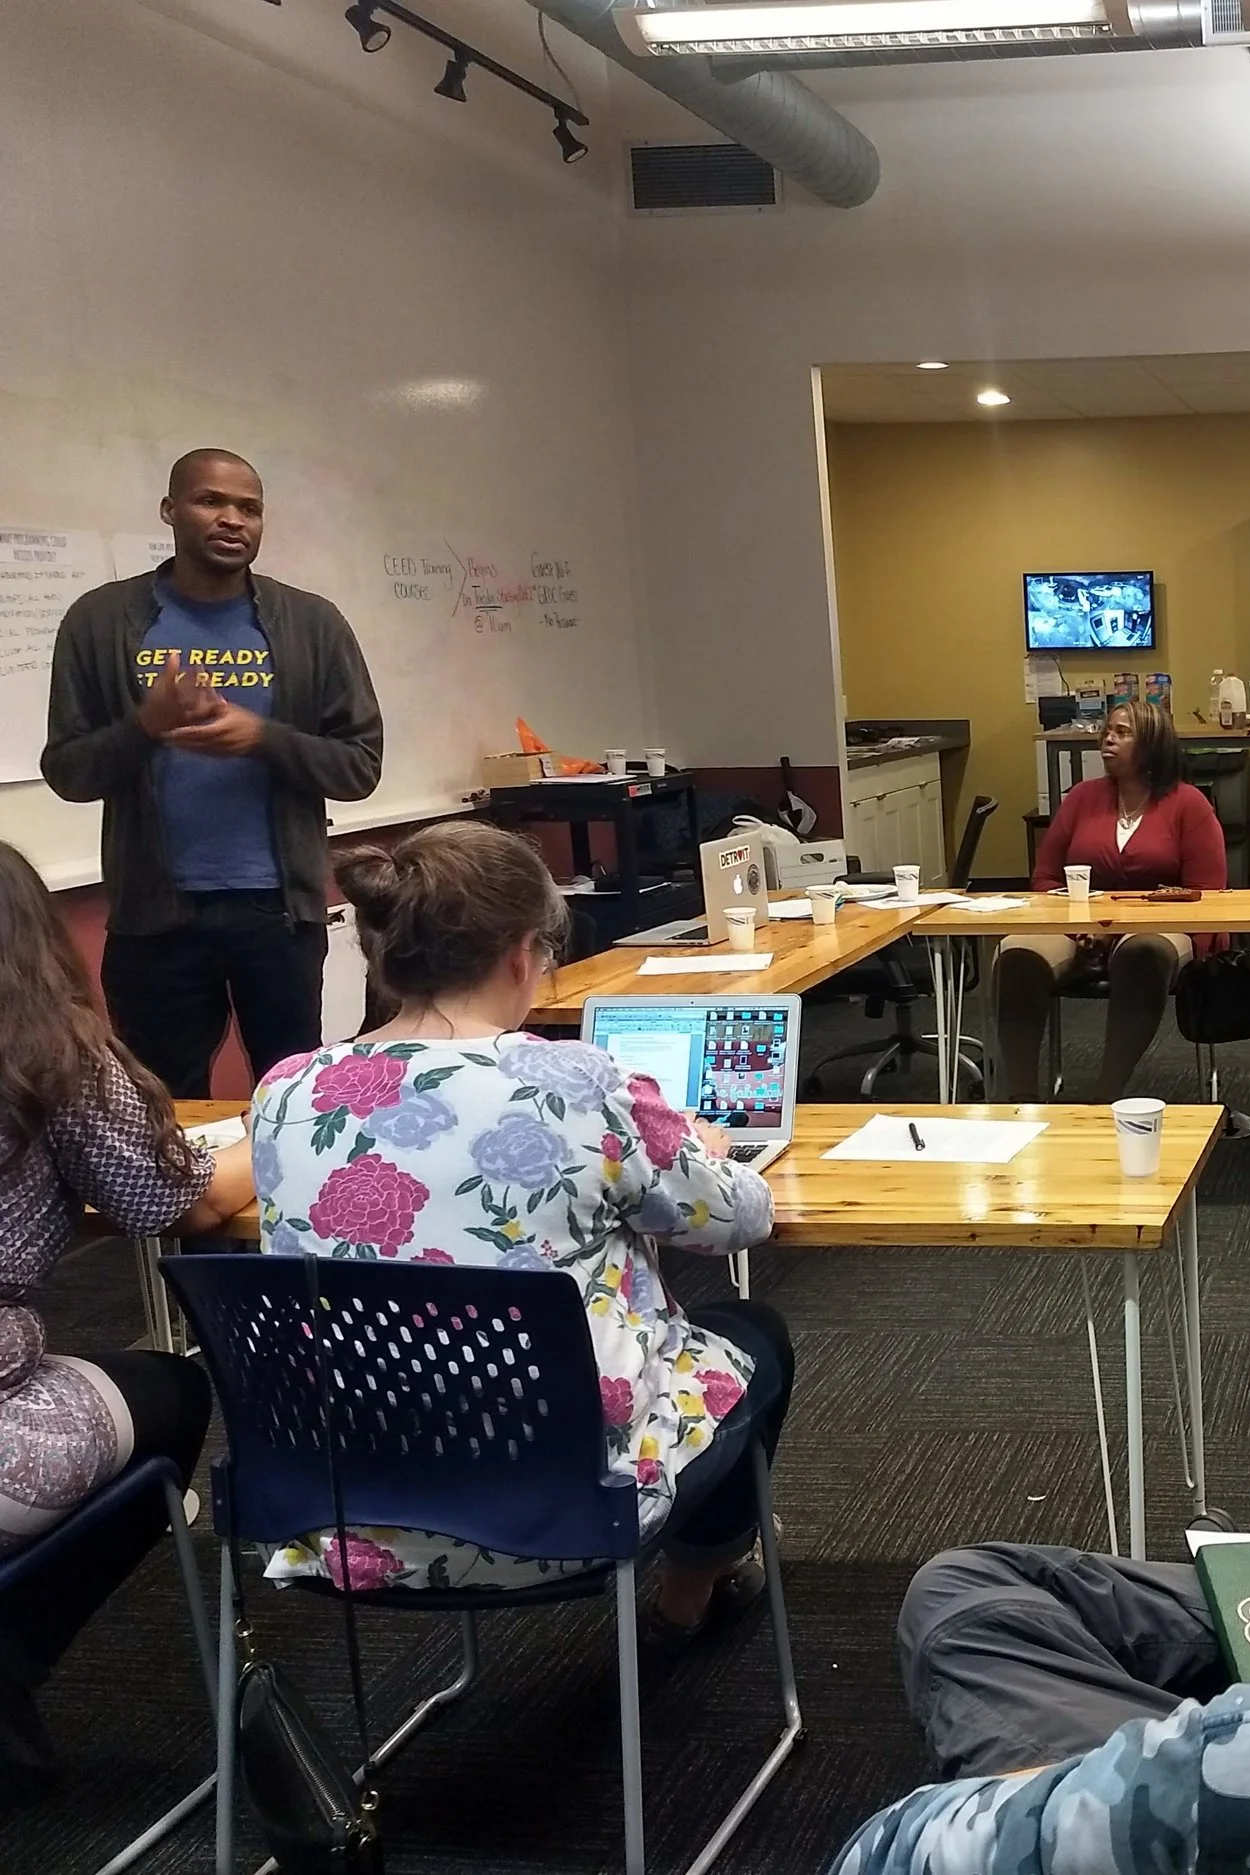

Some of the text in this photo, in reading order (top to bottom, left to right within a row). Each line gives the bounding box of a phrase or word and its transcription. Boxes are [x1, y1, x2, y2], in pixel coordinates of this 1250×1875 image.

[136, 649, 269, 666] GET READY
[195, 672, 275, 688] READY
